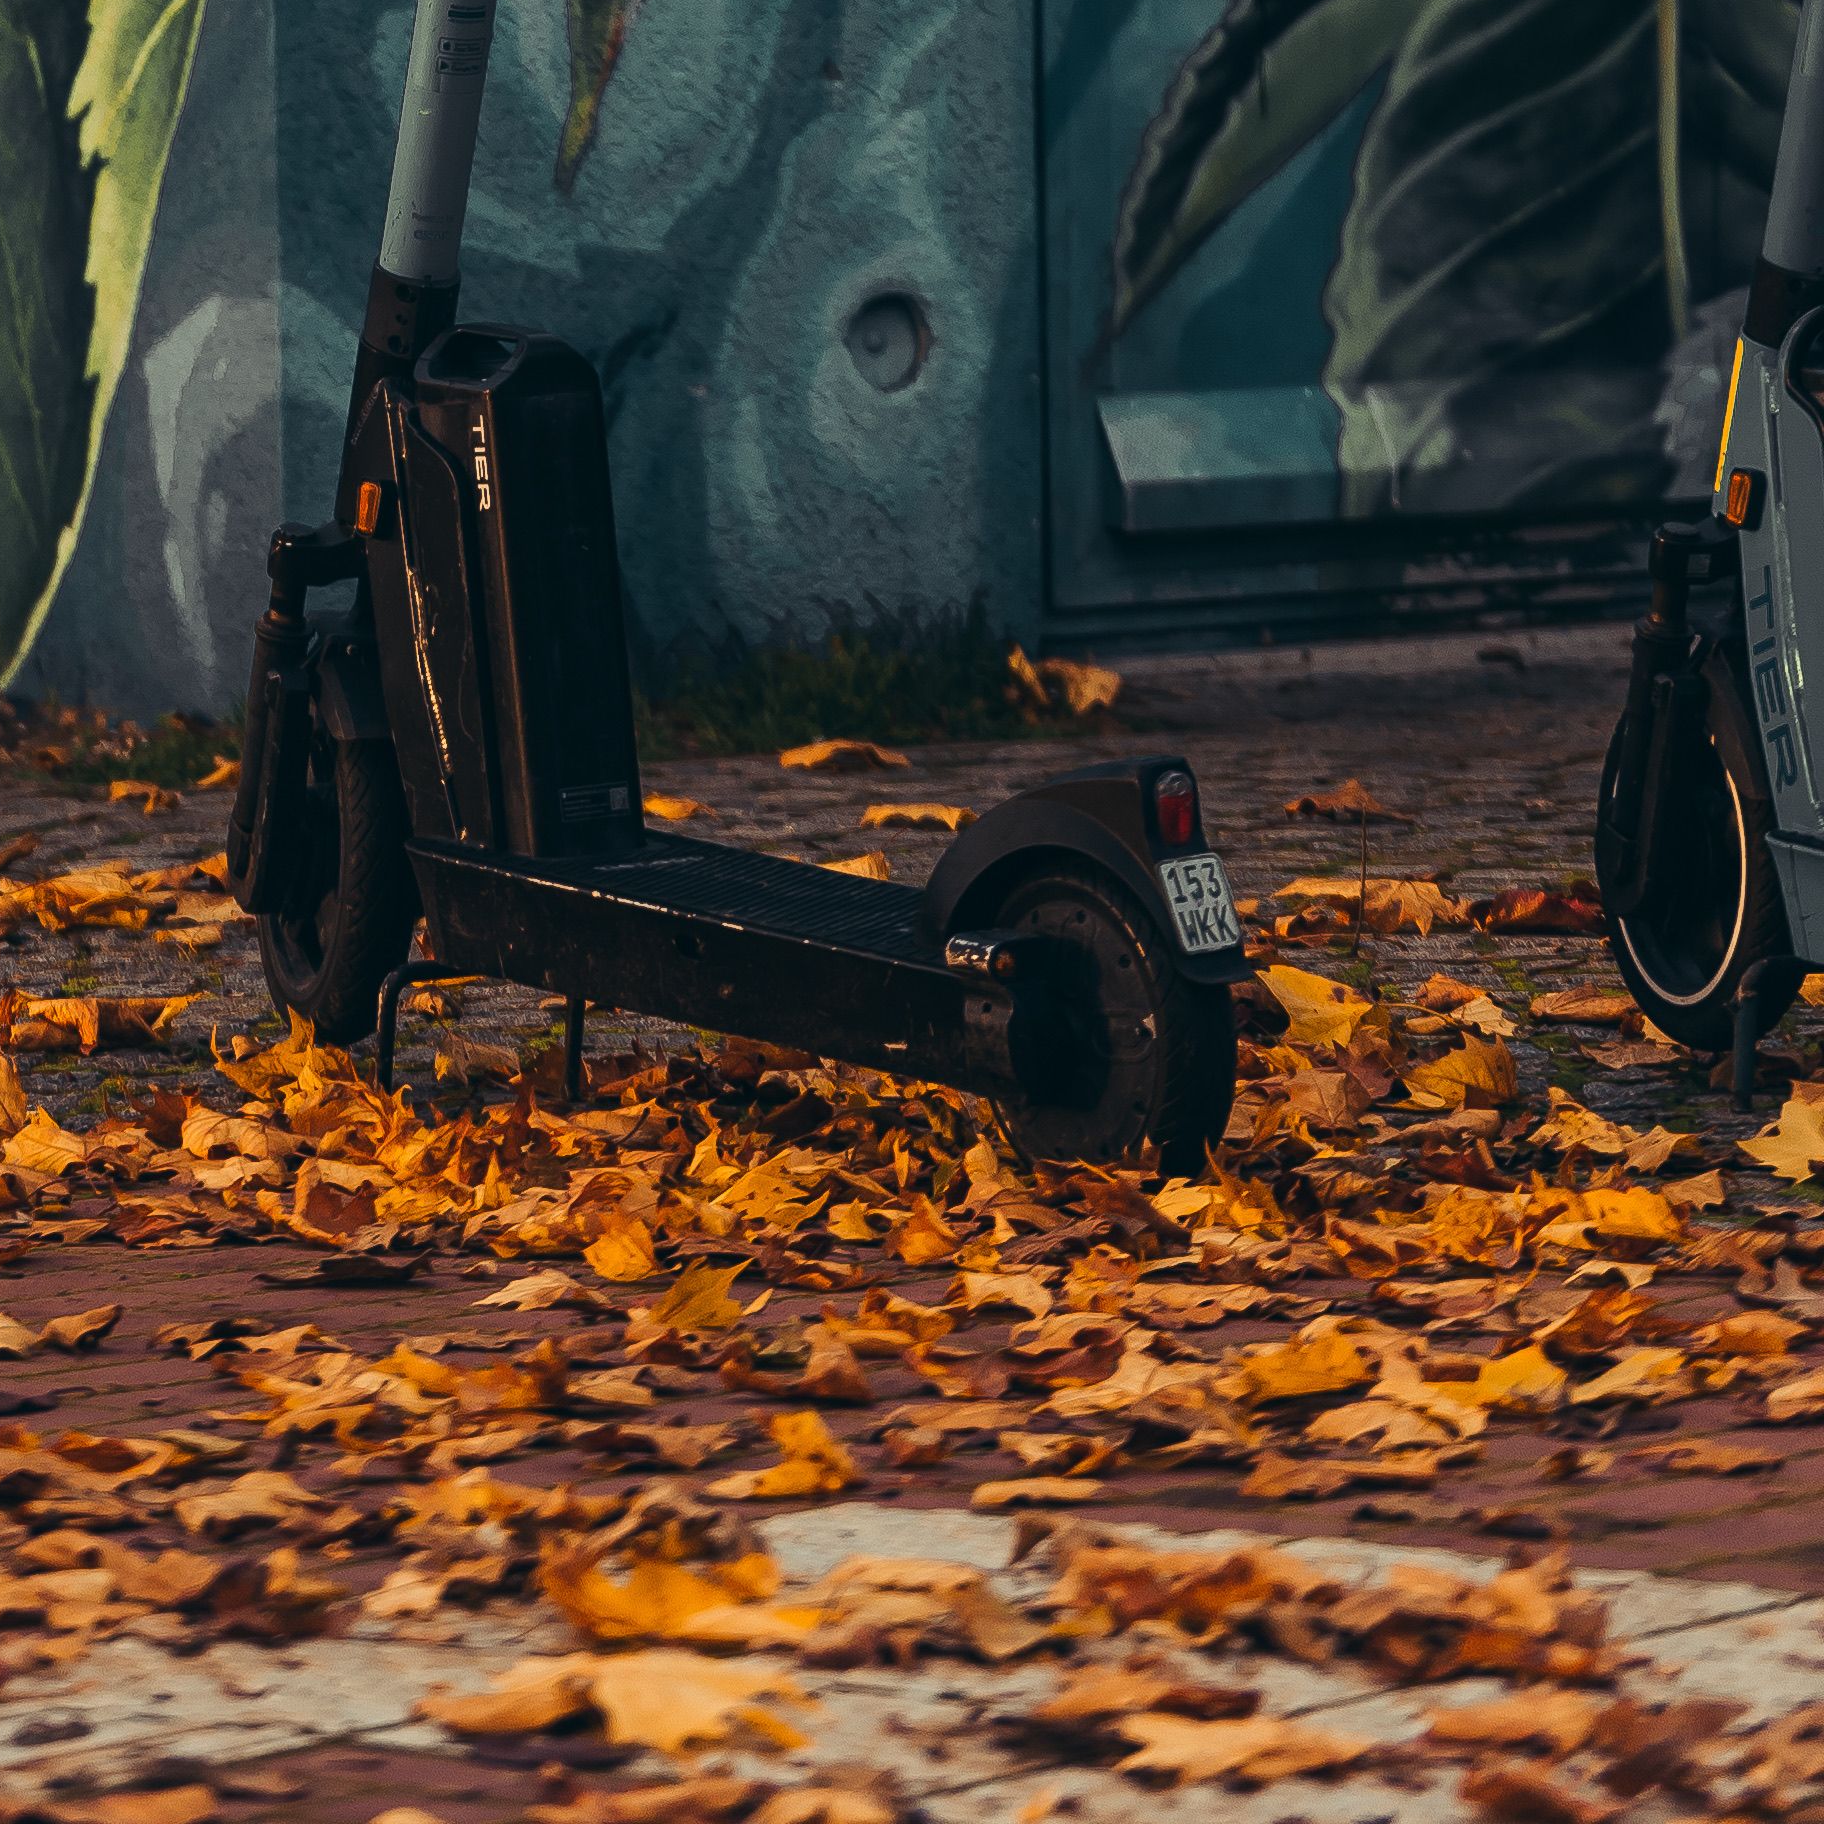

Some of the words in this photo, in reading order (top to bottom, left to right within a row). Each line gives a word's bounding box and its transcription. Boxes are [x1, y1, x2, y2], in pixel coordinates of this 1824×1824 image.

[472, 414, 491, 512] TIER
[1749, 564, 1798, 794] TIER
[1166, 862, 1221, 904] 153
[1179, 904, 1238, 947] WKK
